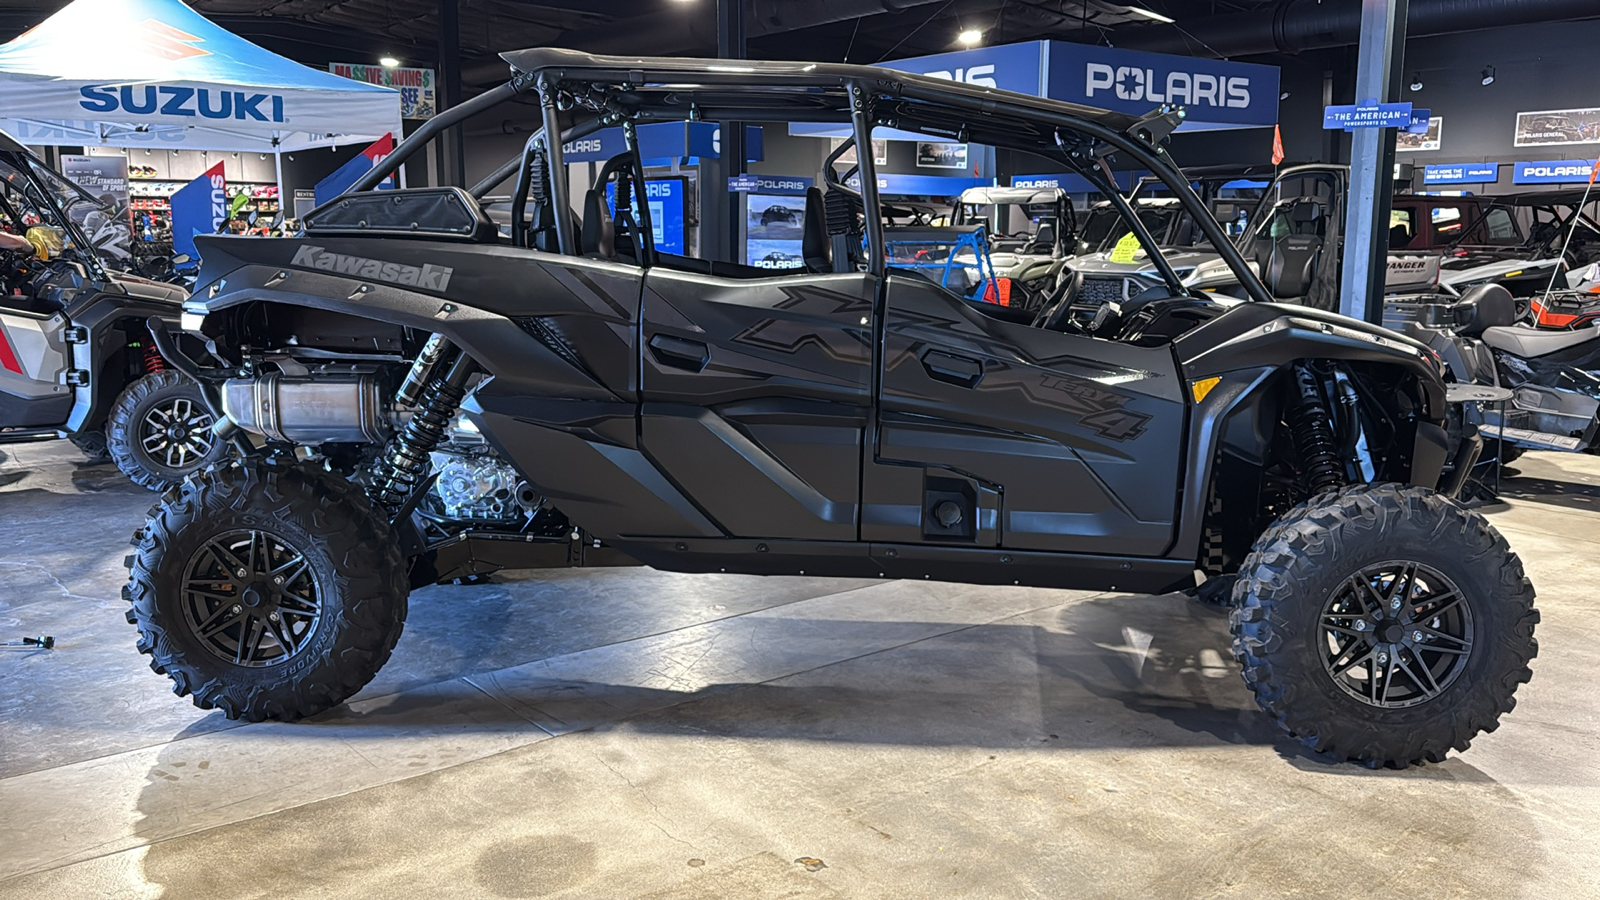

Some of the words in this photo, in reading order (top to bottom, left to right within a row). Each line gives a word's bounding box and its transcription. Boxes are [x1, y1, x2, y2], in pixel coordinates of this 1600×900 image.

[1086, 62, 1250, 108] POLARIS
[401, 87, 419, 104] SEE
[79, 84, 284, 123] SUZUKI
[1354, 111, 1401, 120] AMERICAN
[562, 139, 601, 154] OLARIS
[1524, 166, 1592, 177] POLARIS
[757, 180, 805, 190] POLARIS
[1015, 180, 1059, 189] POLARIS
[210, 174, 226, 234] SUZU
[290, 244, 454, 293] Kawasaki
[754, 260, 803, 269] POLARIS
